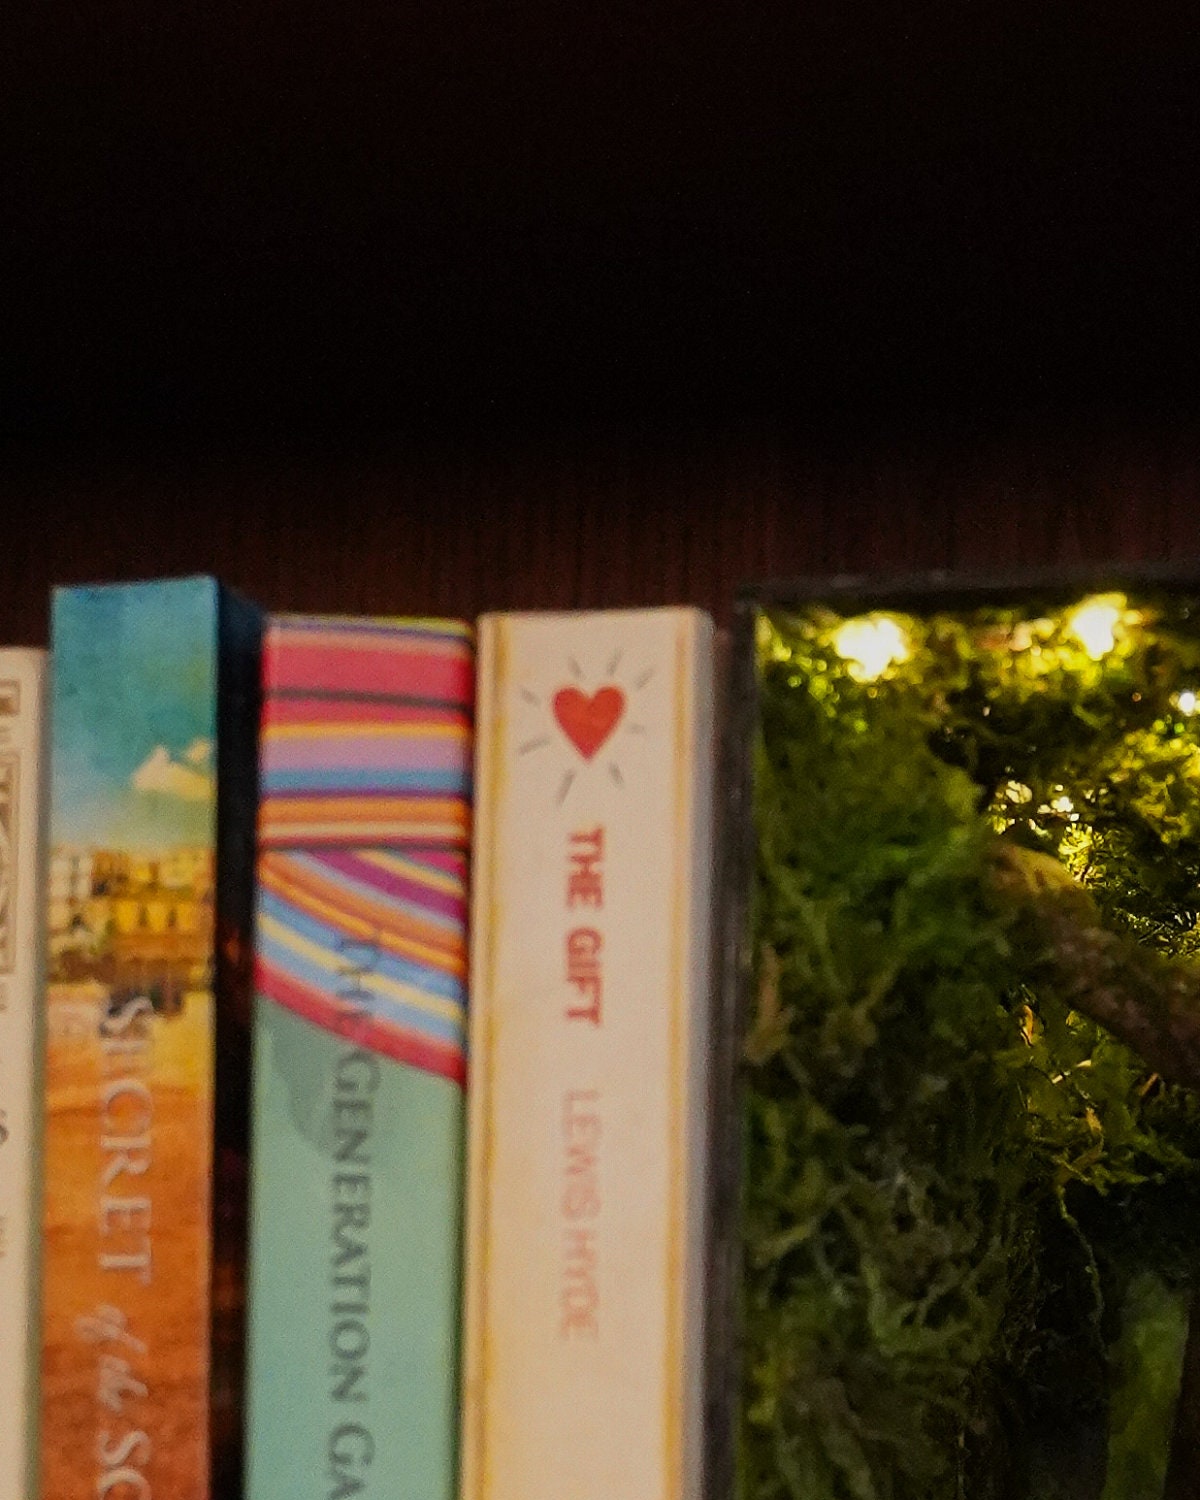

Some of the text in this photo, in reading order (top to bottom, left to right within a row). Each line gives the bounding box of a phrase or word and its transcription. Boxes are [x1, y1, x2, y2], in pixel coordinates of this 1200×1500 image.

[564, 826, 606, 1028] THE GIFT
[99, 994, 154, 1286] SECRET
[327, 1049, 381, 1404] GENERATION
